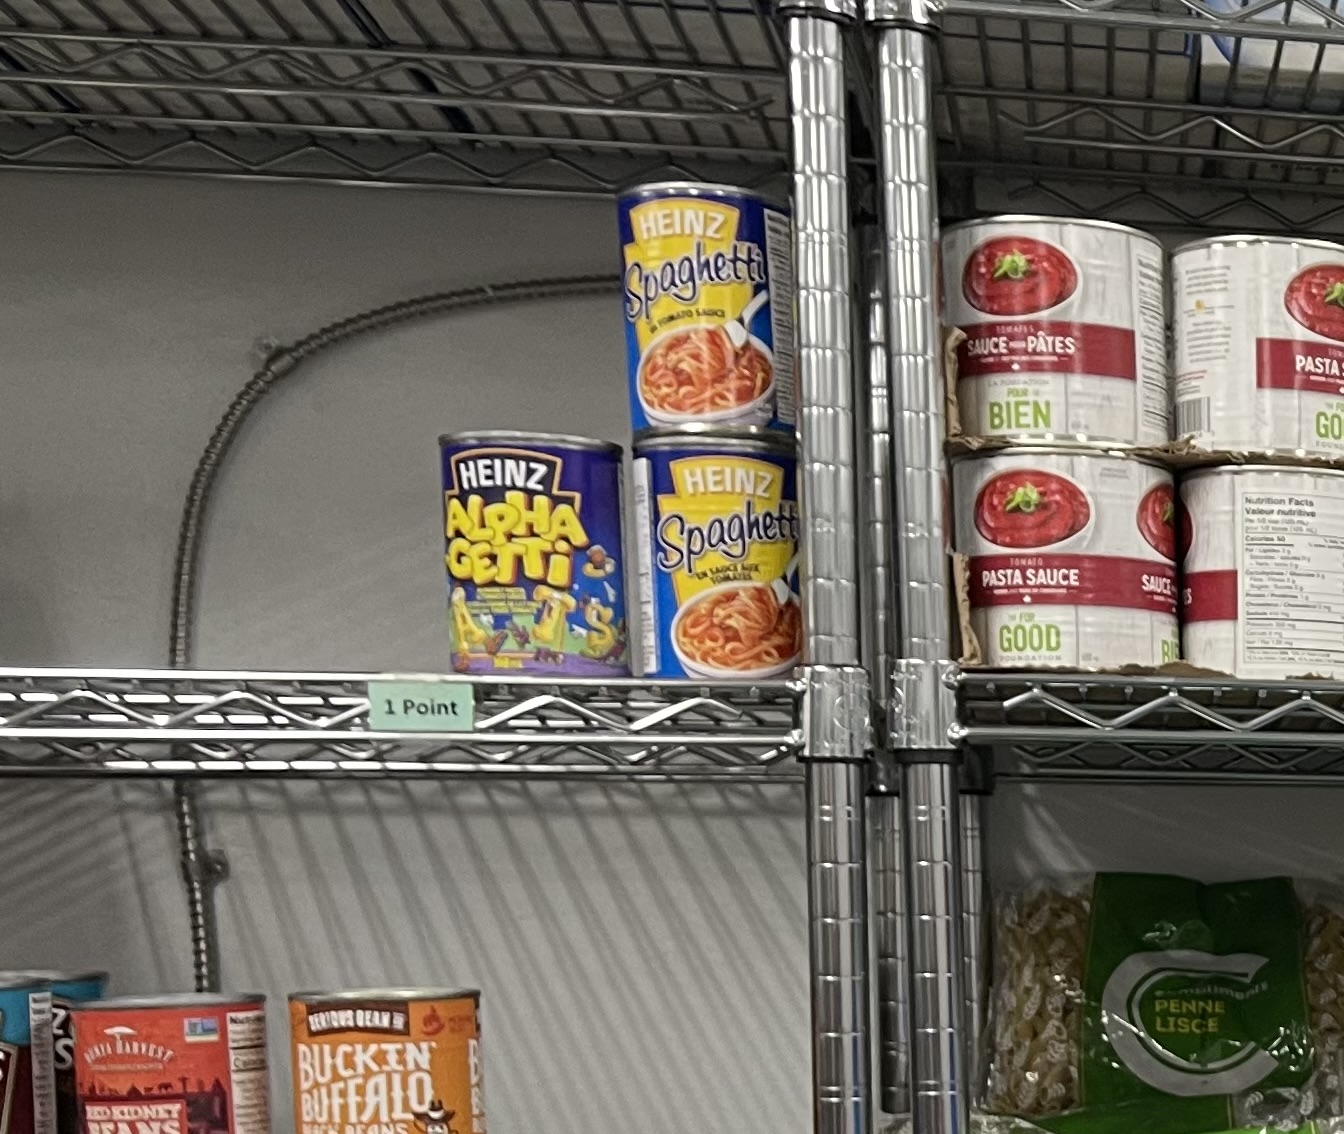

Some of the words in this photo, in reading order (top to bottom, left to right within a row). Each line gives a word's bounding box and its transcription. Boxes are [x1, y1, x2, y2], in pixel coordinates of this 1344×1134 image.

[639, 208, 726, 240] HEINZ
[626, 239, 766, 320] Spaghetti
[967, 335, 1009, 357] SAUCE
[1026, 331, 1076, 356] PÂTES
[1295, 354, 1340, 378] PASTA
[989, 400, 1052, 431] BIEN
[459, 458, 549, 491] HEINZ
[682, 466, 775, 498] HEINZ
[446, 490, 590, 548] ALPHA
[657, 499, 799, 574] Spaghett
[981, 568, 1024, 587] PASTA
[1026, 568, 1080, 587] SAUCE
[1141, 574, 1171, 595] SAUCE
[999, 624, 1062, 653] GOOD
[385, 699, 396, 715] 1
[402, 697, 459, 716] Point
[1155, 1000, 1225, 1014] PENNE
[1155, 1017, 1218, 1033] LISCE
[301, 1070, 433, 1123] BUFFALO
[112, 1104, 182, 1120] KIDNEY
